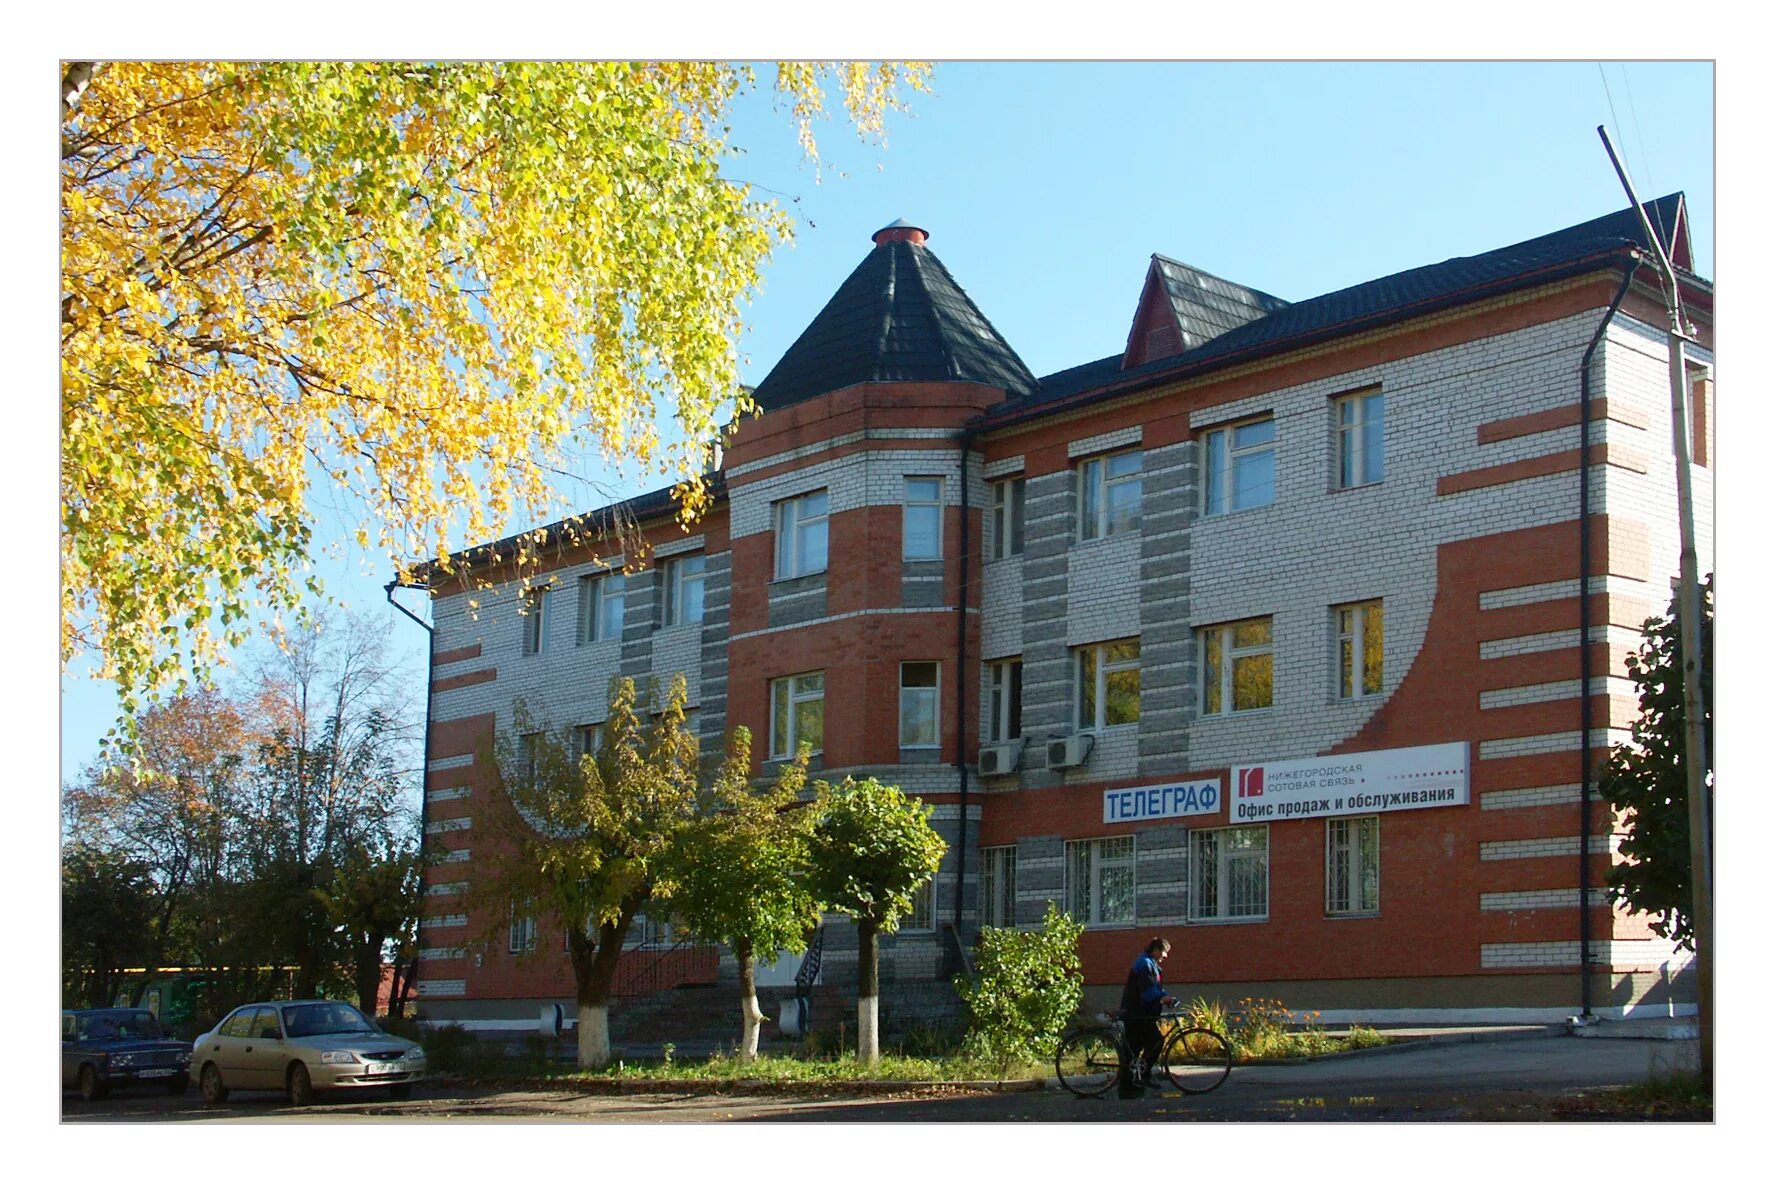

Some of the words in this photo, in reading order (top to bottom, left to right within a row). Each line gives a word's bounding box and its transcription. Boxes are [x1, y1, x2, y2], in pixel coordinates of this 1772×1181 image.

[1267, 764, 1363, 780] НИЖЕГОРОДСКАЯ
[1267, 779, 1317, 793] СОТОВАЯ
[1319, 776, 1356, 788] СВЯЗЬ
[1107, 784, 1217, 819] ТЕЛЕГРАФ
[1238, 802, 1274, 820] Офис
[1278, 799, 1330, 816] продаж
[1335, 797, 1344, 810] и
[1348, 788, 1456, 809] обслуживания
